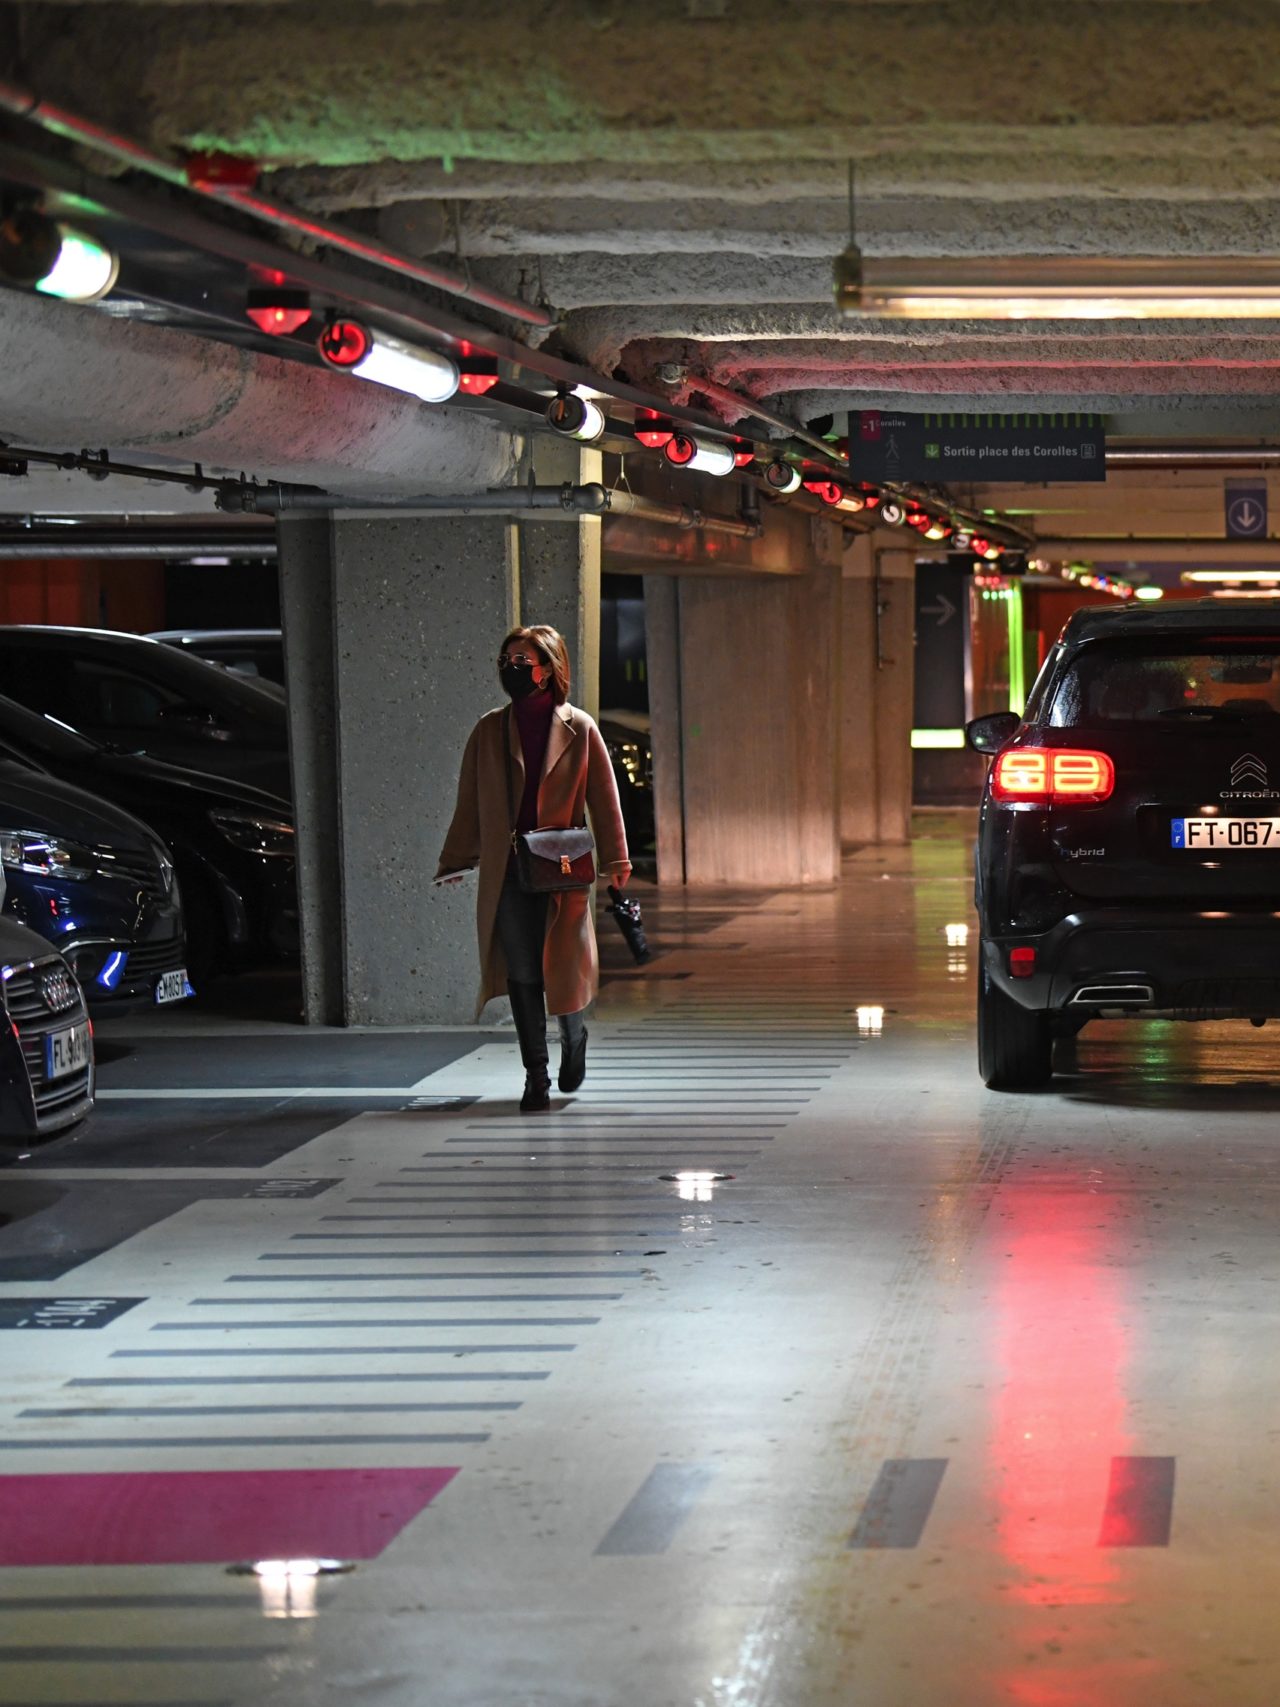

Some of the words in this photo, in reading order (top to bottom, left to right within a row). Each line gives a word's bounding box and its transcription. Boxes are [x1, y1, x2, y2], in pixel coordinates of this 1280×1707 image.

[862, 419, 875, 432] -1
[943, 445, 976, 457] Sortie
[978, 445, 1009, 460] place
[1011, 445, 1031, 457] des
[1033, 445, 1078, 457] Corolles
[1060, 847, 1105, 858] hybrid
